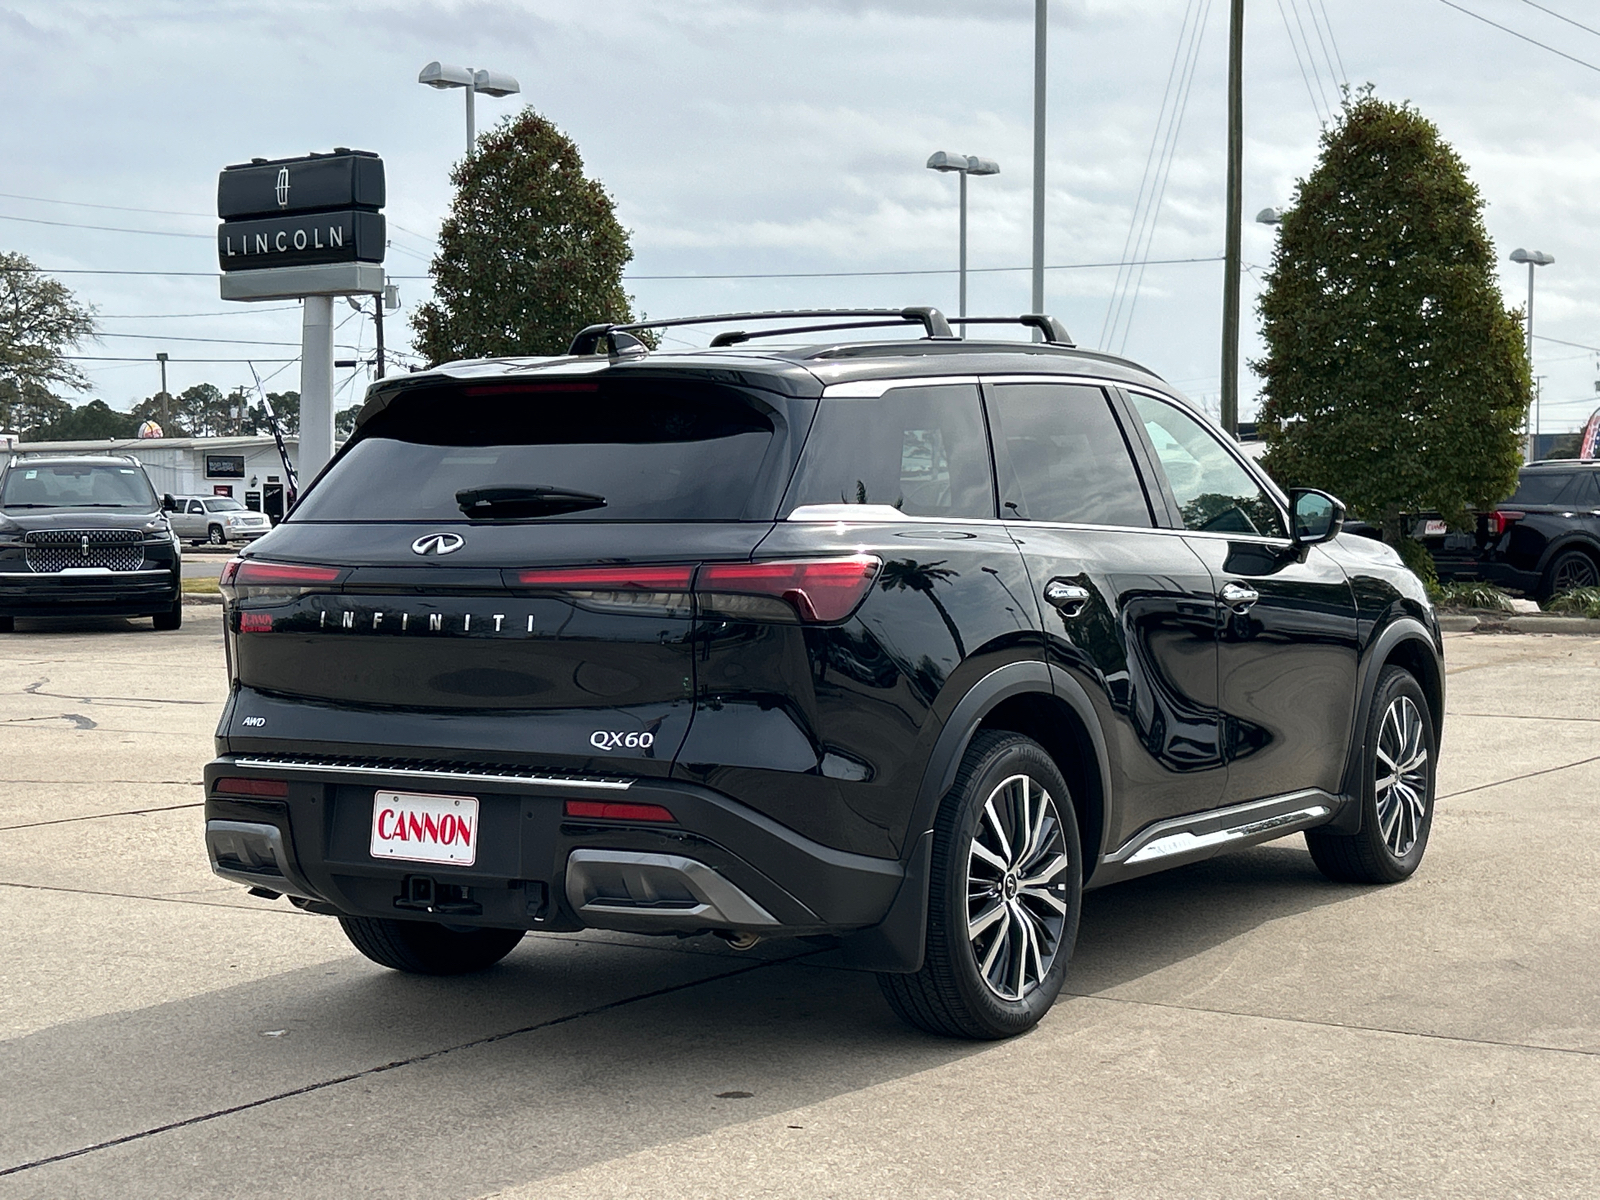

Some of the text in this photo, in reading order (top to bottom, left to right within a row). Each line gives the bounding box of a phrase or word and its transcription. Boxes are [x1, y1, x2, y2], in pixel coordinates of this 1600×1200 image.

[226, 225, 344, 257] LINCOLN
[319, 611, 534, 632] INFINITI
[242, 716, 266, 728] AWD
[590, 731, 654, 752] QX60
[1018, 746, 1071, 804] BRIDGESTONE
[378, 809, 473, 847] CANNON
[972, 978, 1031, 1027] BRIDGESTONE
